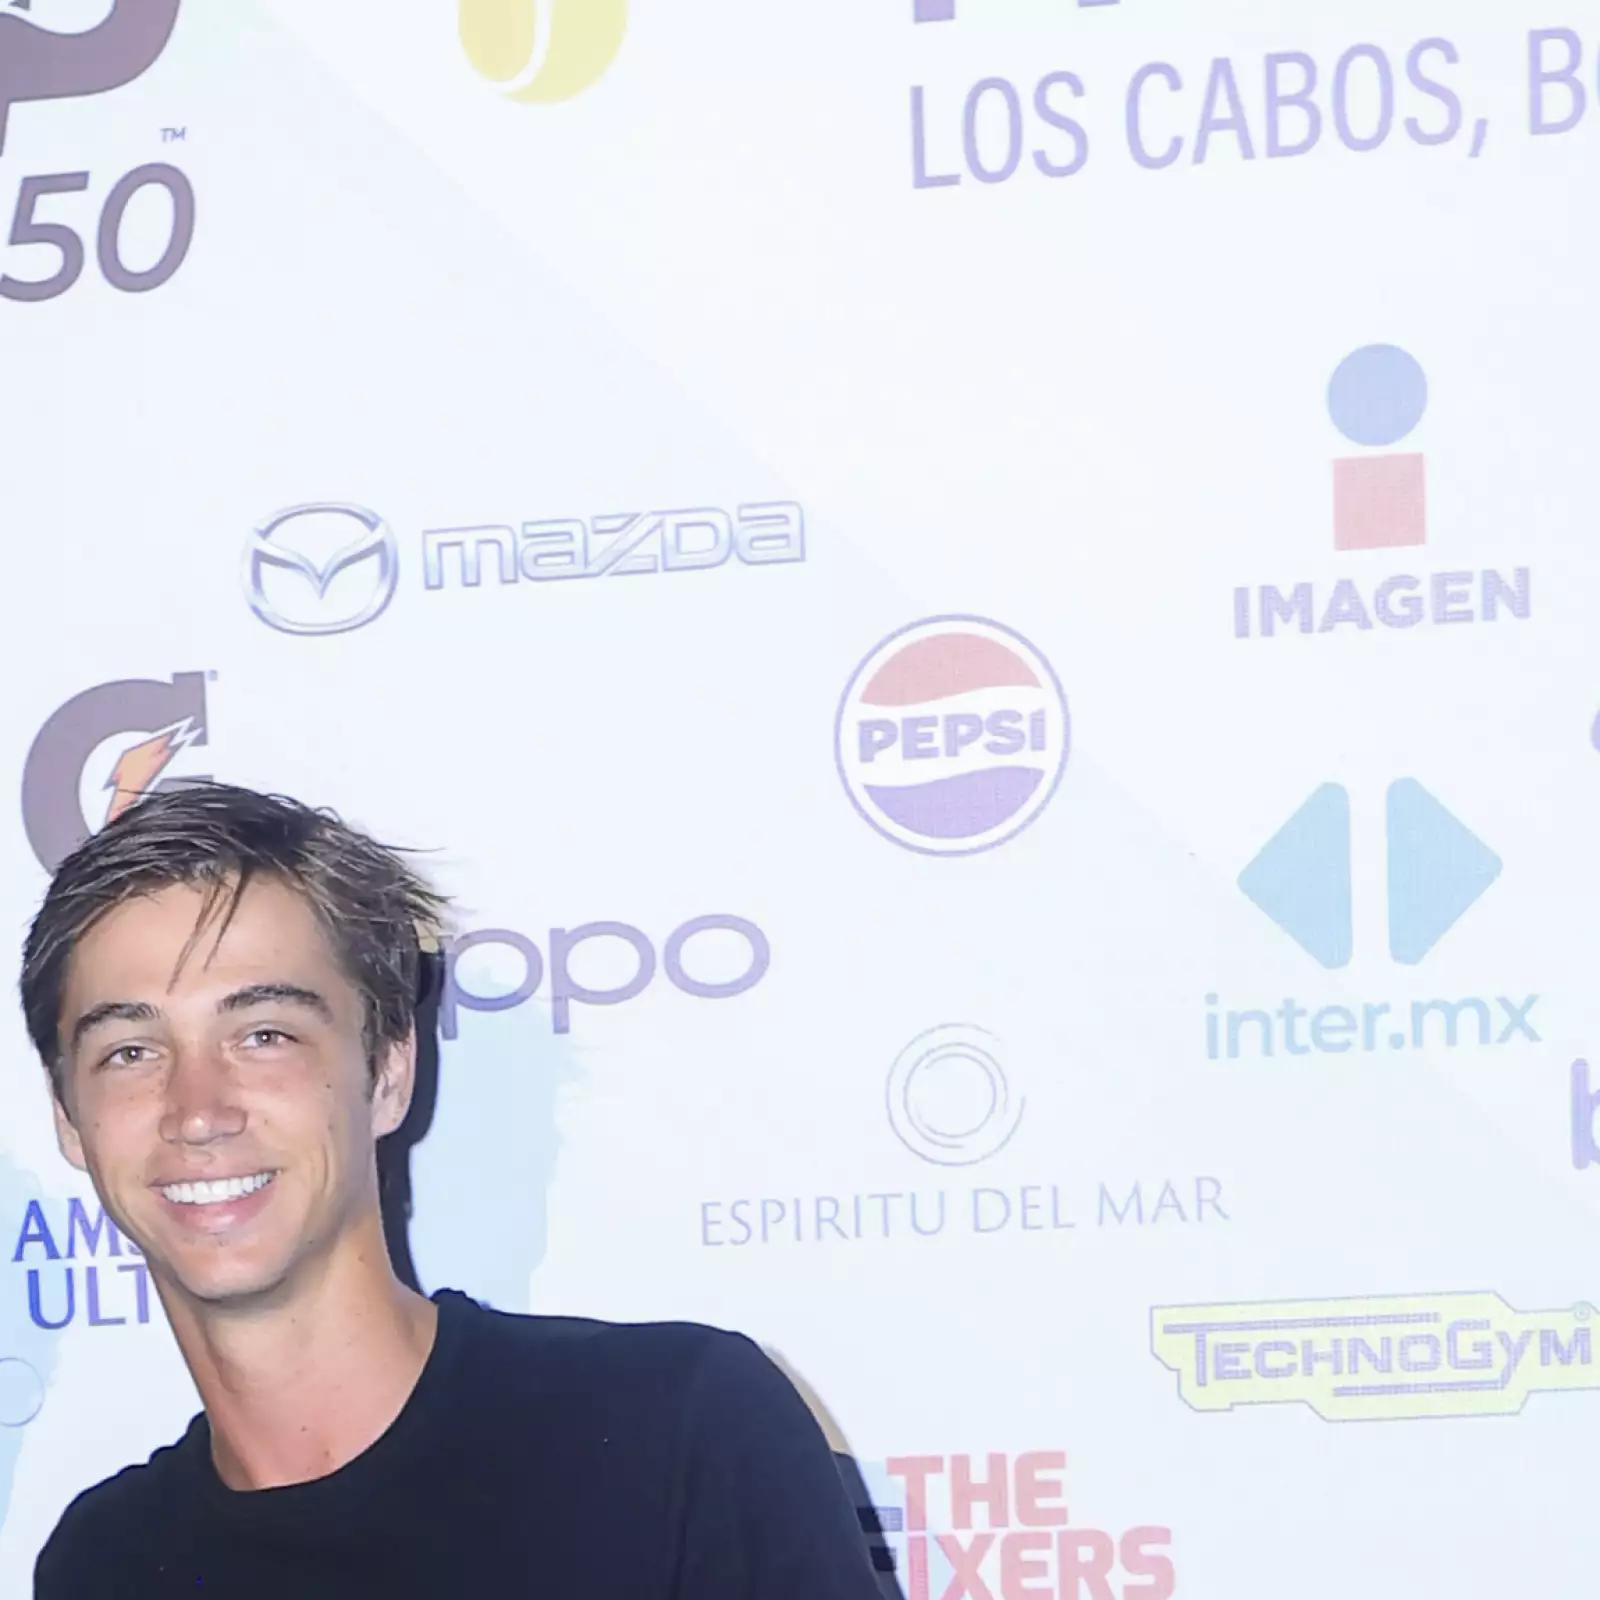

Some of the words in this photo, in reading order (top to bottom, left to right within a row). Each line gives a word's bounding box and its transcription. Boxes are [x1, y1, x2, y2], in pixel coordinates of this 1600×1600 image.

[911, 70, 1089, 188] LOS
[1125, 36, 1488, 170] CABOS,
[1233, 567, 1531, 638] IMAGEN
[858, 709, 1046, 762] PEPSI
[441, 914, 770, 1040] ppo
[1205, 992, 1542, 1059] inter.mx
[701, 1192, 946, 1247] ESPIRITU
[971, 1186, 1075, 1233] DEL
[1097, 1176, 1230, 1227] MAR
[886, 1451, 1068, 1530] THE
